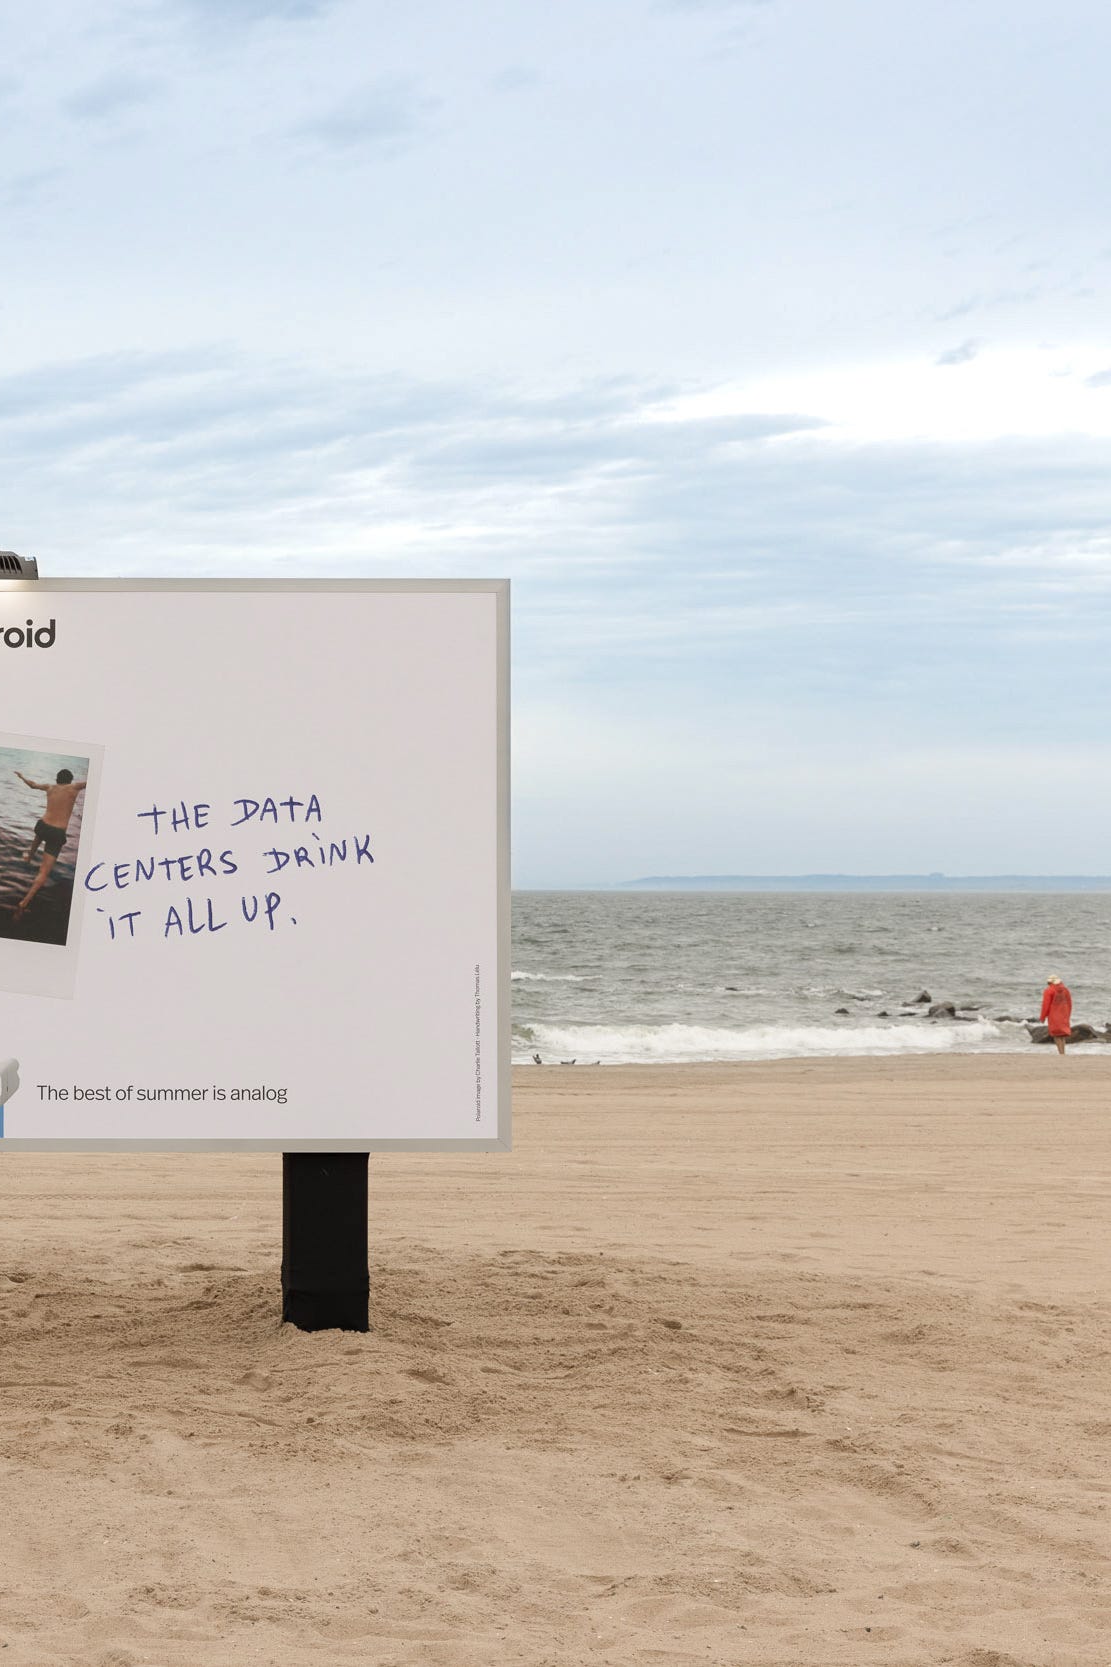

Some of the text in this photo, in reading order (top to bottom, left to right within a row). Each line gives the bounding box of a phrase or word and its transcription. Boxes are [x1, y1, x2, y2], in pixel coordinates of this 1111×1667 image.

[137, 793, 323, 836] THE DATA
[84, 847, 239, 893] CENTERS
[164, 896, 229, 939] ALL
[241, 891, 299, 931] UP.
[37, 1084, 288, 1105] The best of summer is analog
